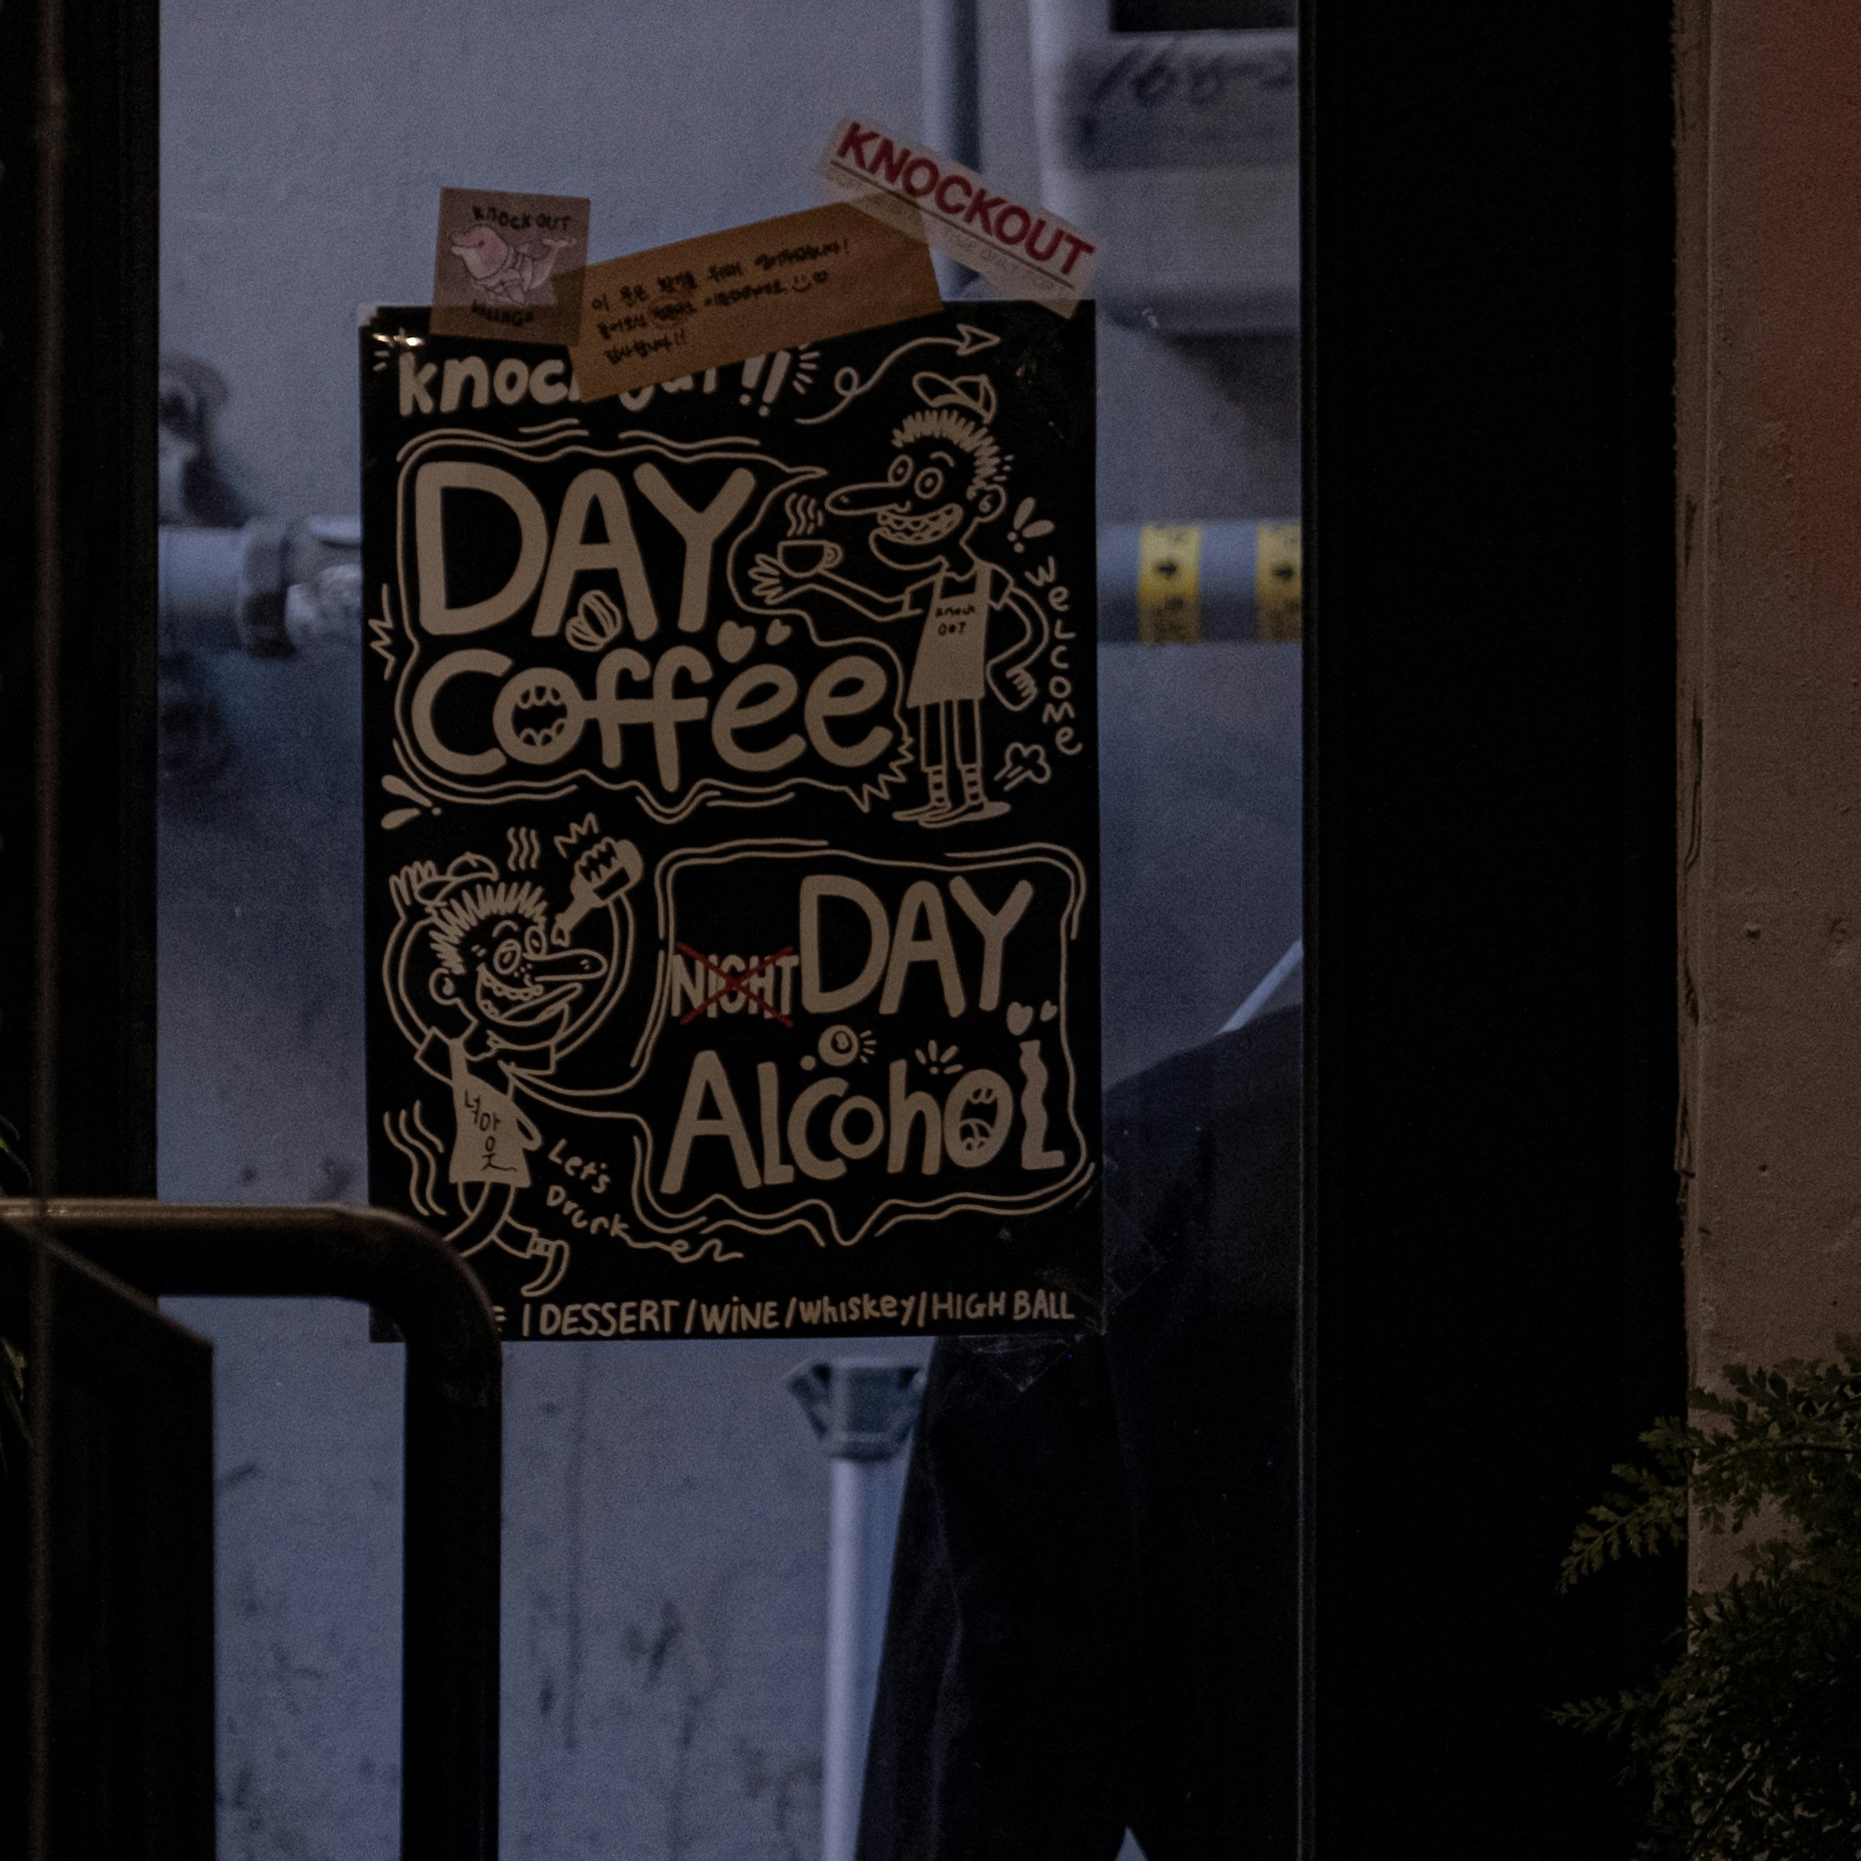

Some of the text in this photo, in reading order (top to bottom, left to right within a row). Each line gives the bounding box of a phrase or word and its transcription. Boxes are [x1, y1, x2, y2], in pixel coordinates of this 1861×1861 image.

[837, 121, 1095, 275] KNOCKOUT
[592, 297, 611, 313] 이
[399, 350, 582, 419] knoc
[414, 461, 757, 642] DAY
[411, 644, 894, 793] Coffee
[800, 873, 1034, 1017] DAY
[1012, 1288, 1076, 1321] BALL
